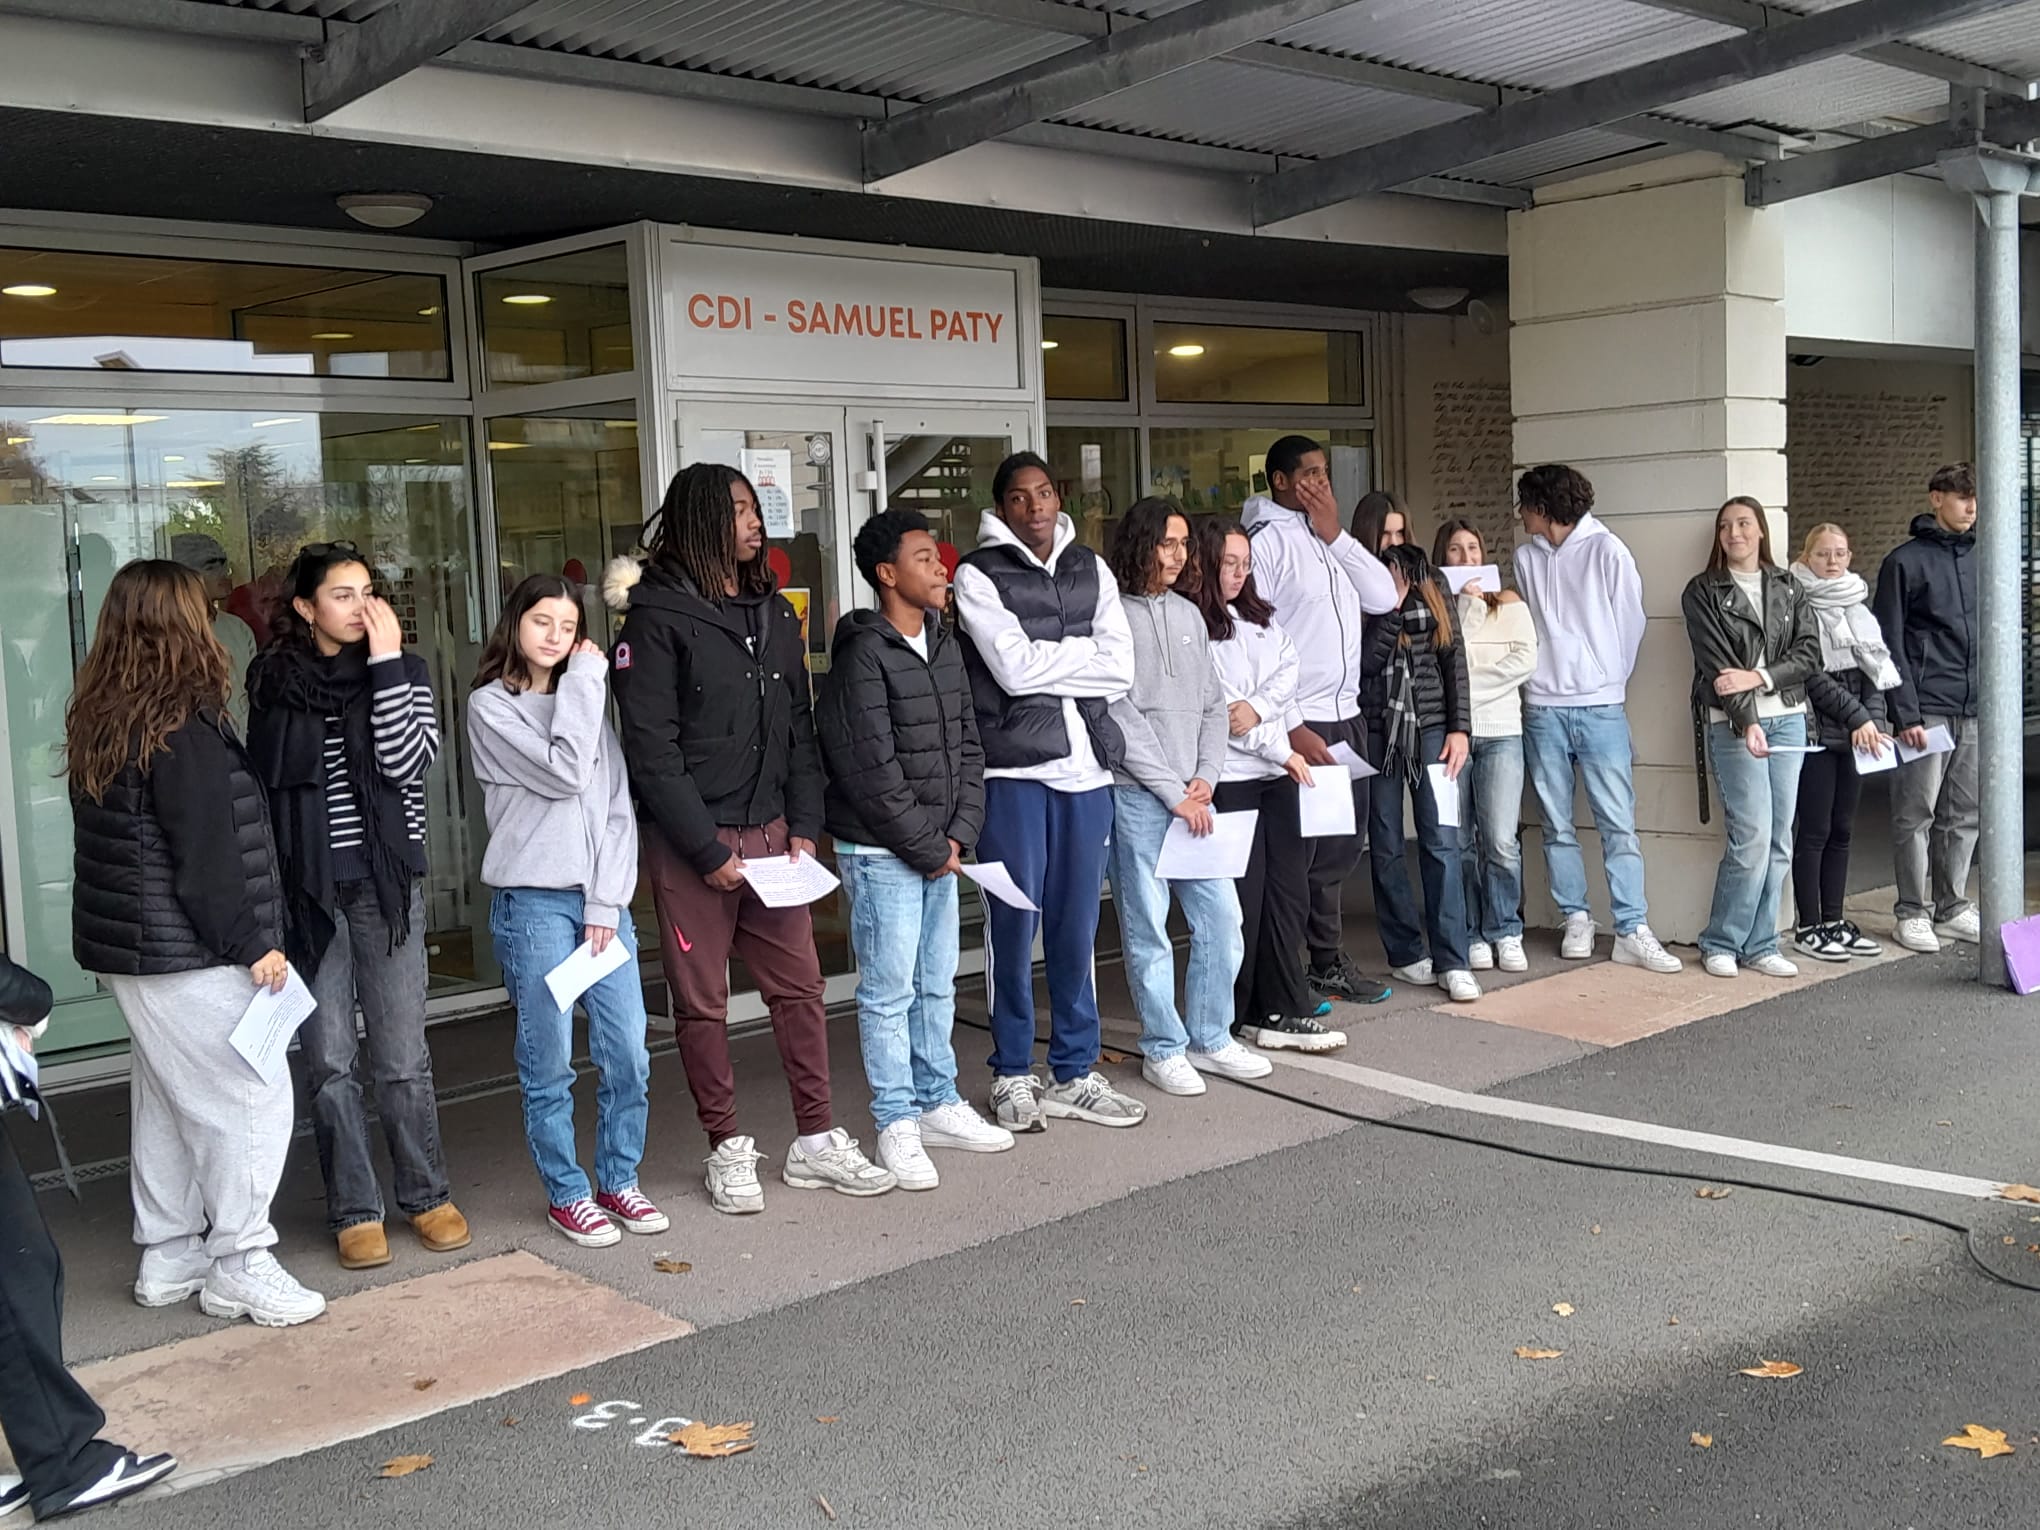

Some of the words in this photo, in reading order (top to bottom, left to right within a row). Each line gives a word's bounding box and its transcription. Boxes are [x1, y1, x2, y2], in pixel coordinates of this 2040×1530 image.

[688, 293, 752, 330] CDI
[764, 314, 777, 322] -
[787, 299, 922, 339] SAMUEL
[930, 309, 1003, 343] PATY
